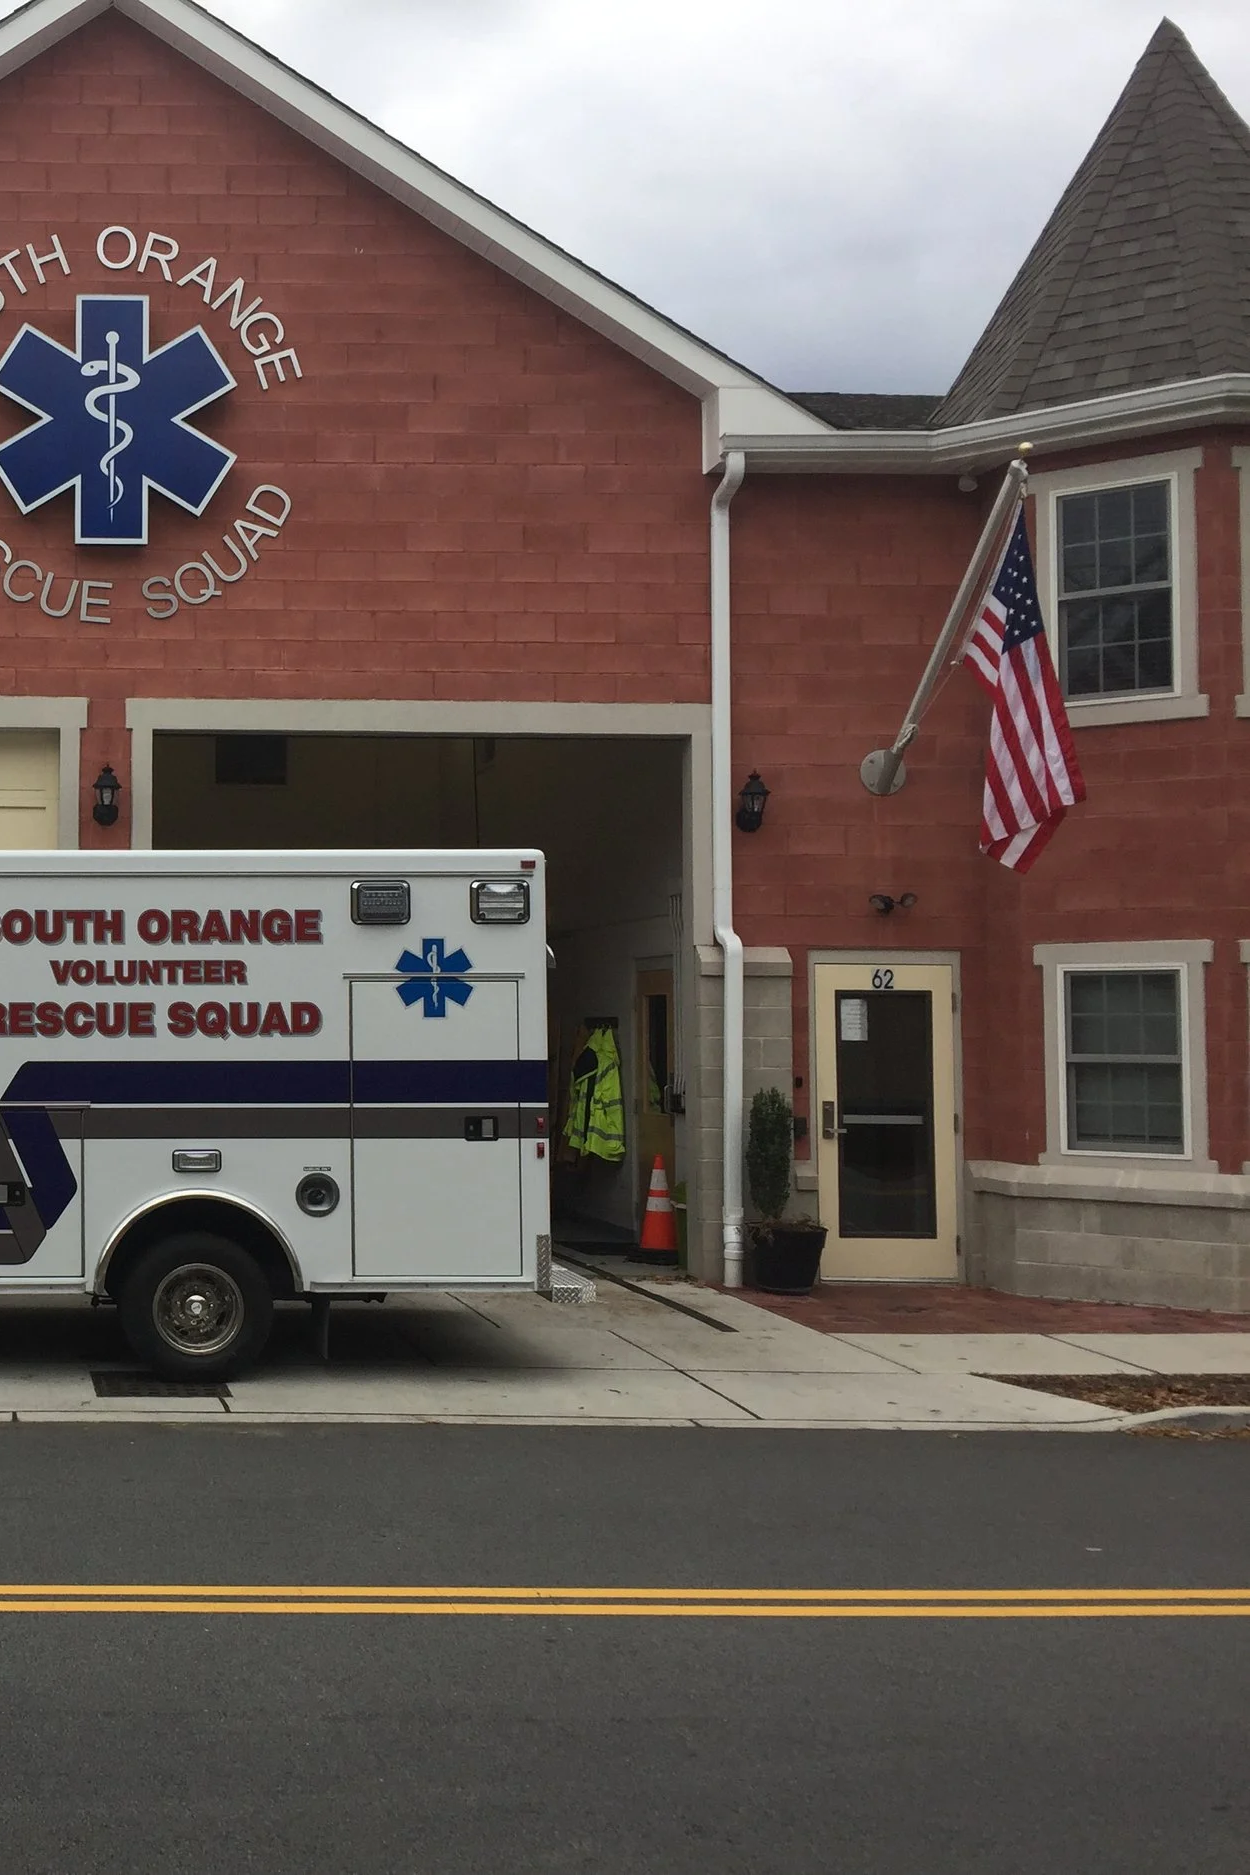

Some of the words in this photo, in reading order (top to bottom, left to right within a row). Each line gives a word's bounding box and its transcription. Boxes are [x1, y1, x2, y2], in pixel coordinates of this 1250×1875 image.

[96, 225, 303, 390] ORANGE
[141, 484, 292, 619] SQUAD
[137, 908, 323, 945] ORANGE
[49, 959, 248, 986] VOLUNTEER
[872, 969, 894, 989] 62
[167, 1001, 323, 1041] SQUAD
